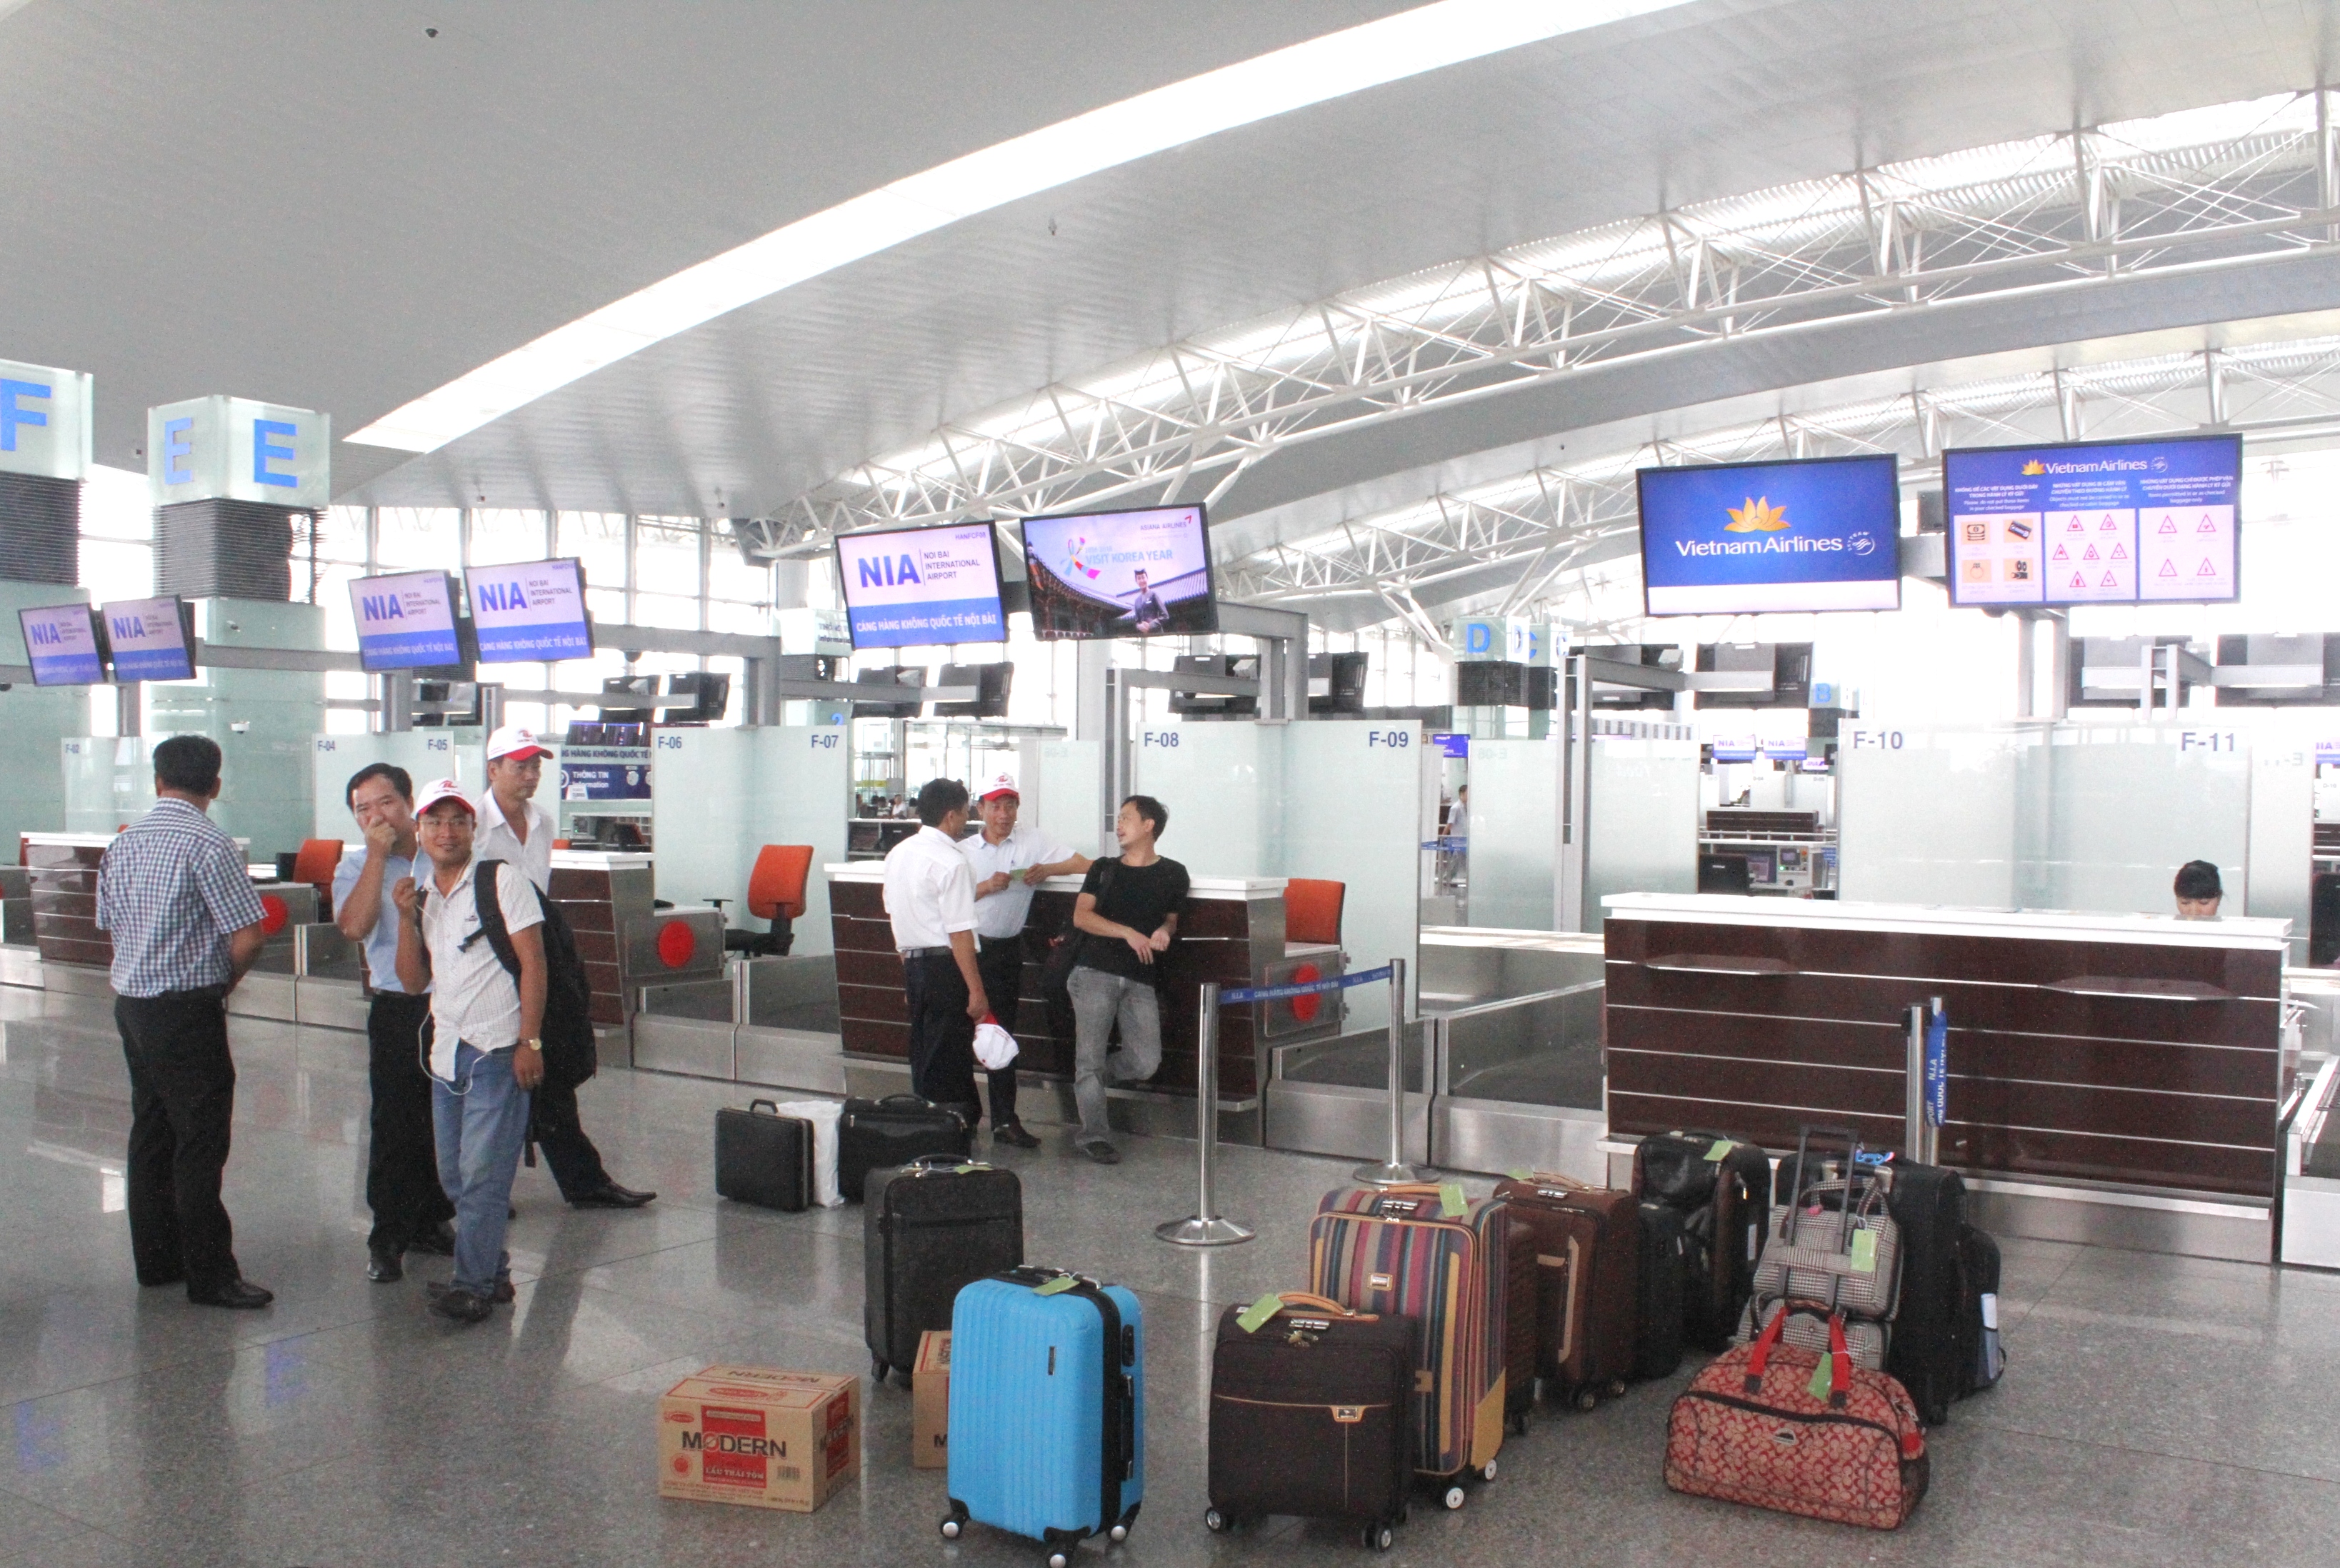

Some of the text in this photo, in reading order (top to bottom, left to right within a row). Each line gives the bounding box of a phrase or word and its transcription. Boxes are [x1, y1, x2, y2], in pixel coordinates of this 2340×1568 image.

[0, 378, 51, 451] F
[164, 417, 193, 484] E
[254, 419, 298, 488] E
[2046, 463, 2099, 474] Vietnam
[2099, 460, 2147, 471] Airlines
[1676, 539, 1761, 556] Vietnam
[1764, 536, 1842, 553] Airlines
[926, 559, 980, 569] INTERNATIONAL
[1086, 549, 1173, 564] VISIT KOREA YEAR
[858, 554, 921, 588] NIA
[927, 571, 956, 580] AIRPORT
[479, 582, 527, 611] NIA
[362, 594, 404, 621] NIA
[112, 616, 146, 639] NIA
[879, 617, 900, 630] HÀNG
[901, 615, 929, 629] KHÔNG
[930, 614, 951, 629] QUỐC
[953, 613, 963, 626] TẾ
[965, 612, 980, 626] NỘI
[982, 611, 996, 624] BÀI
[31, 623, 61, 644] NIA
[1466, 623, 1491, 654] D
[1814, 683, 1831, 703] B
[318, 741, 336, 751] F-04
[428, 739, 448, 750] F-05
[659, 736, 681, 749] F-06
[811, 734, 839, 748] F-07
[1144, 731, 1179, 748] F-08
[1369, 731, 1409, 748] F-09
[1854, 731, 1903, 749] F-10
[2181, 732, 2234, 751] F-11
[571, 748, 591, 757] HÀNG
[593, 749, 618, 757] KHÔNG
[619, 749, 638, 759] QUỐC
[573, 769, 596, 779] THÔNG
[682, 1431, 786, 1459] MODERN
